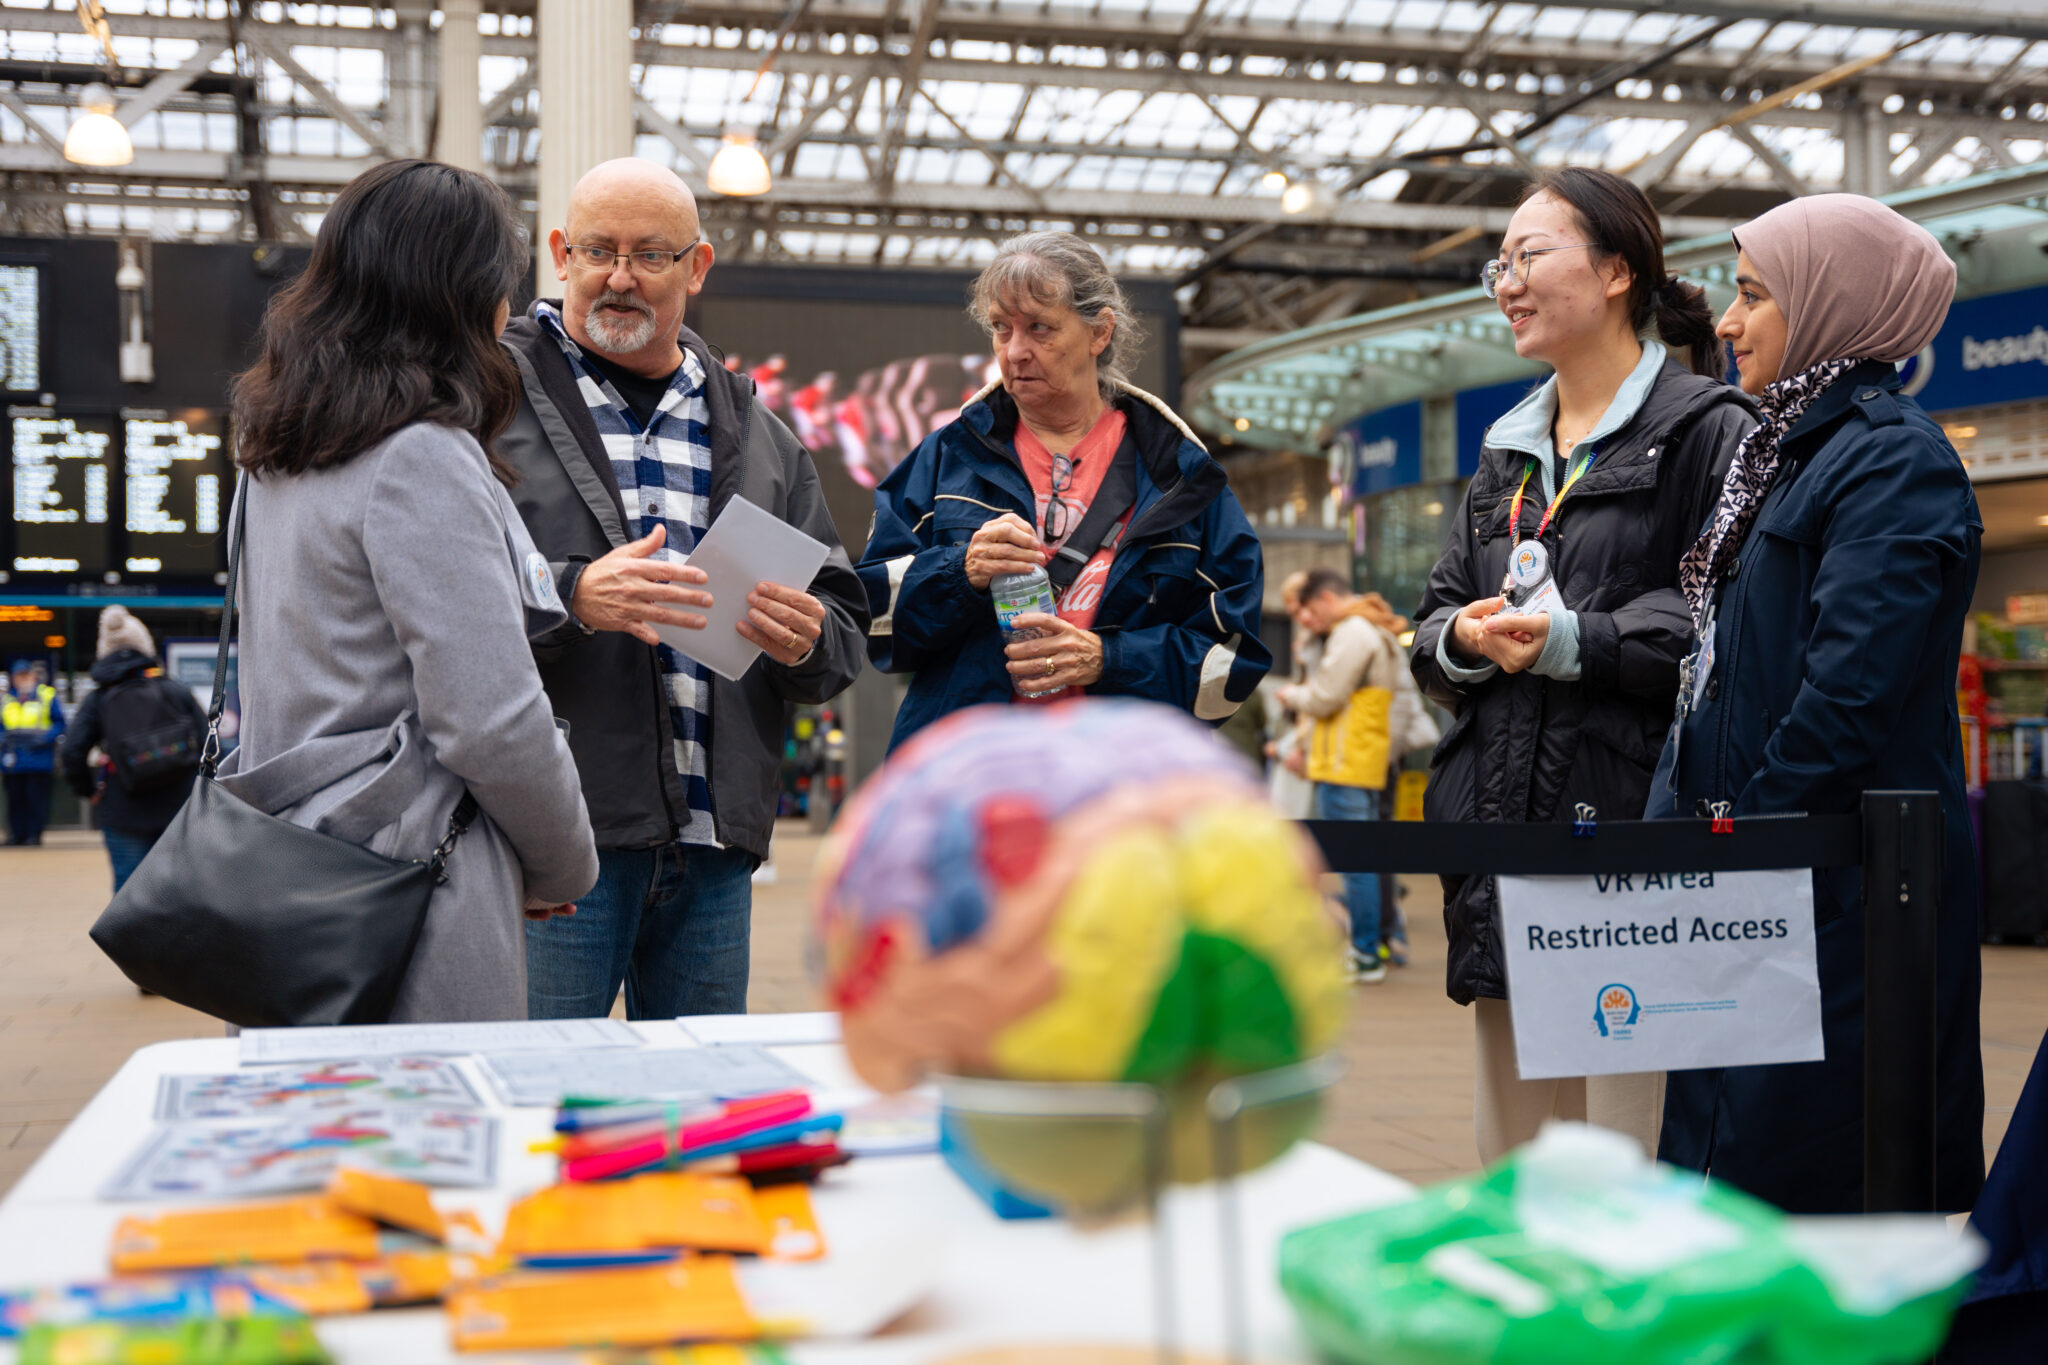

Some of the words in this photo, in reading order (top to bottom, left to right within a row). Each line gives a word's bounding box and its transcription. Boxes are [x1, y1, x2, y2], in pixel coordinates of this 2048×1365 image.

[1594, 873, 1634, 893] VR
[1643, 872, 1715, 890] Area
[1527, 916, 1679, 951] Restricted
[1689, 917, 1788, 943] Access
